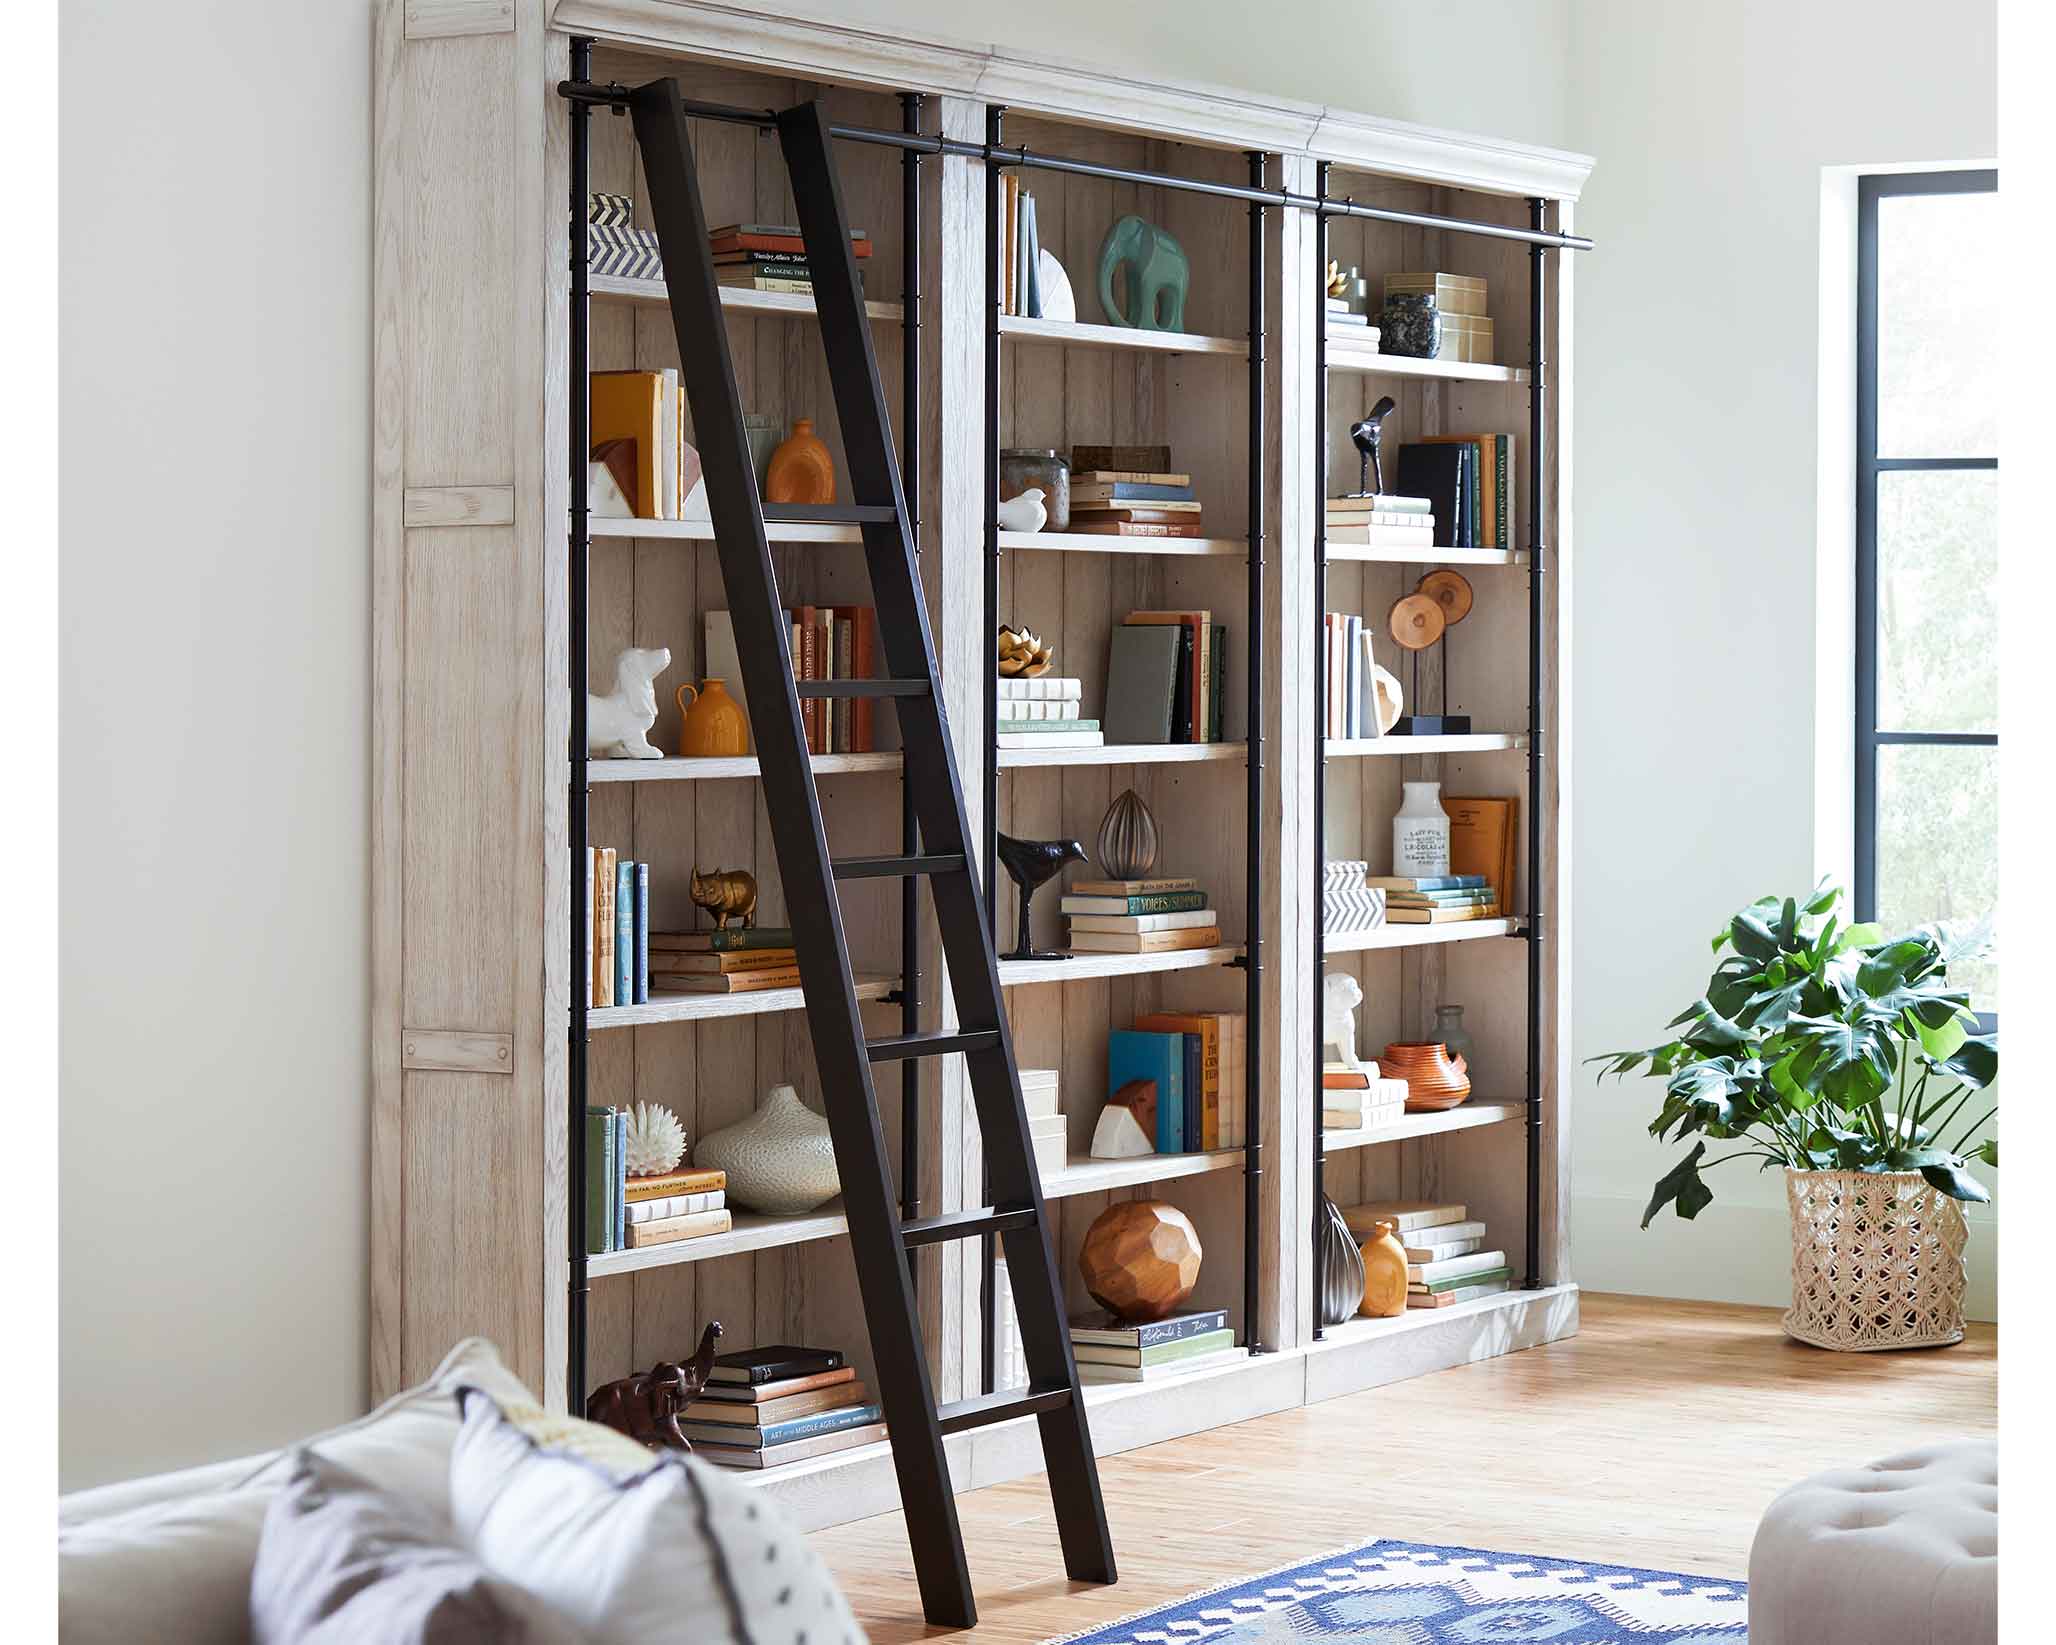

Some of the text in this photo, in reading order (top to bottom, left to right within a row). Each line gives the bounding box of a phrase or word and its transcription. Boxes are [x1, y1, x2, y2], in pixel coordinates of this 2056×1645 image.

[1141, 896, 1168, 912] VOICES
[770, 1430, 783, 1441] ART
[795, 1423, 818, 1434] MIDDLE
[820, 1419, 837, 1430] AGES
